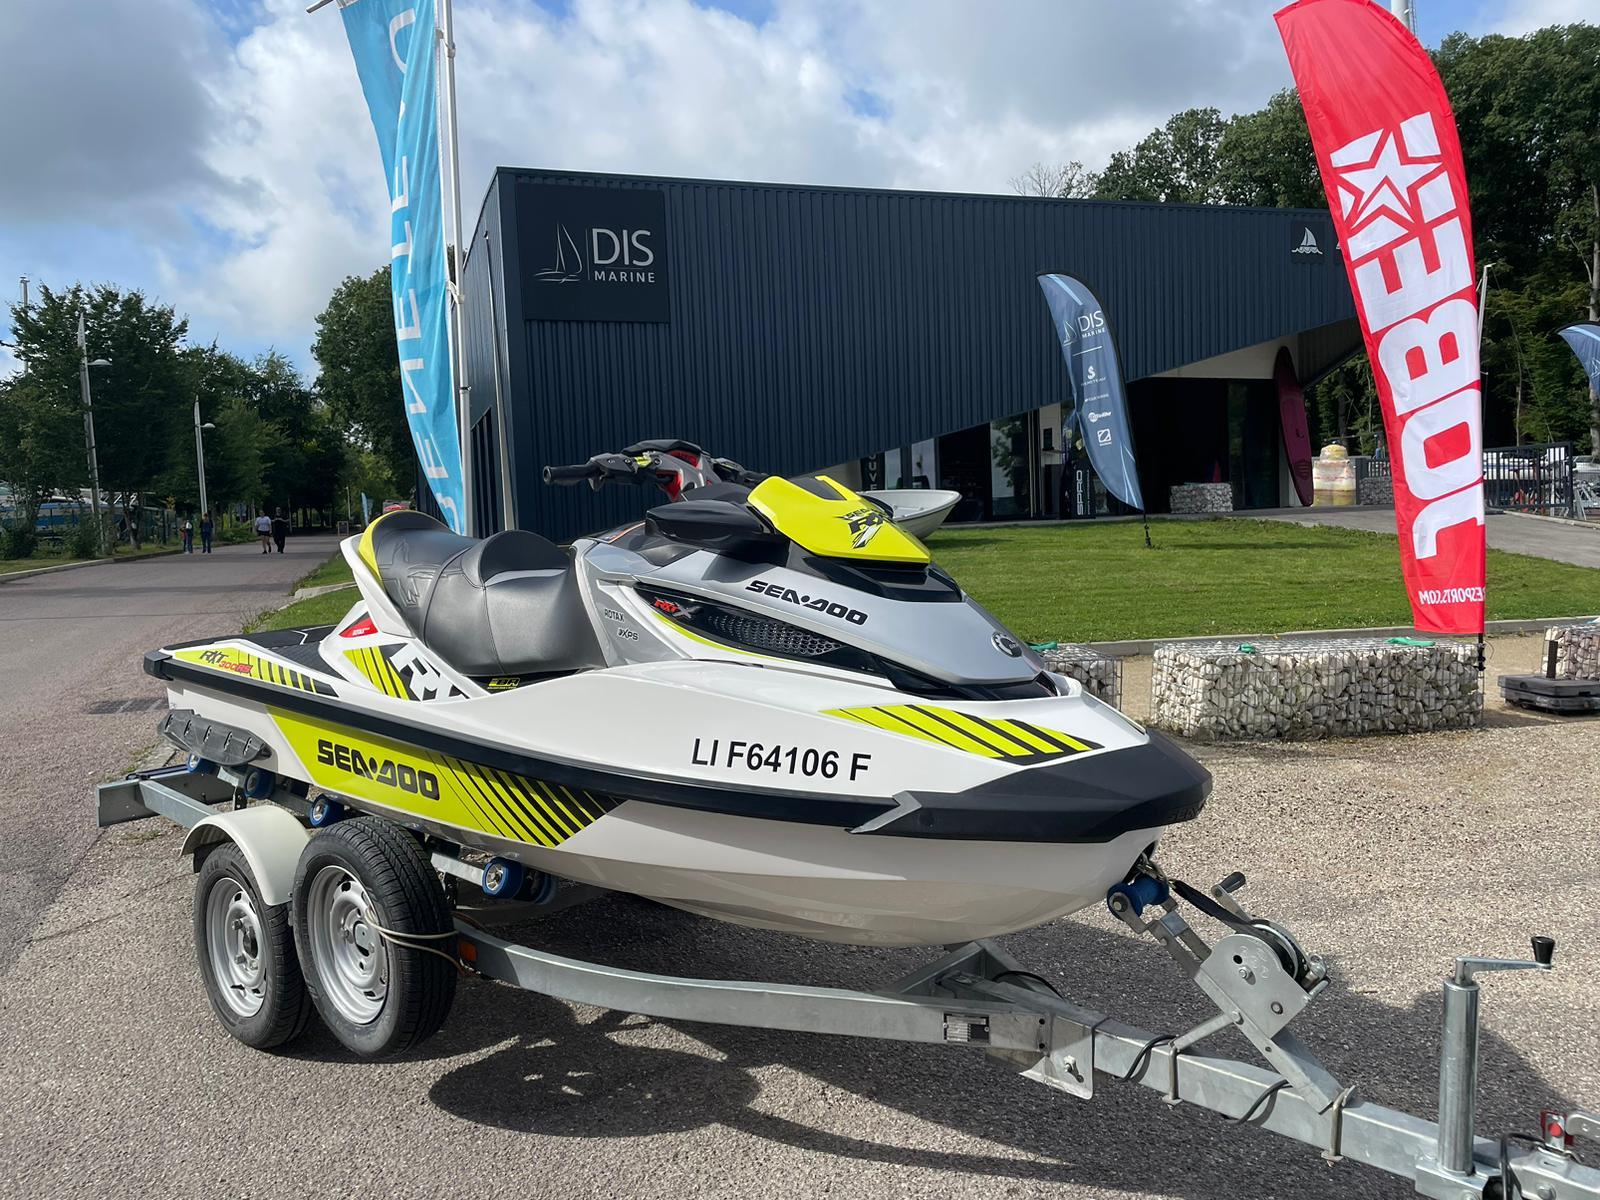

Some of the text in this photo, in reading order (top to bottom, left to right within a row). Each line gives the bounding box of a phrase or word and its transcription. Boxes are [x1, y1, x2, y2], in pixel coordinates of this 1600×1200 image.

[592, 228, 654, 266] DIS
[594, 271, 655, 283] MARINE
[1077, 310, 1104, 332] DIS
[1082, 327, 1106, 338] MARINE
[1076, 470, 1084, 516] SPRO
[604, 608, 625, 624] ROTAX
[691, 738, 872, 781] LI F64106 F
